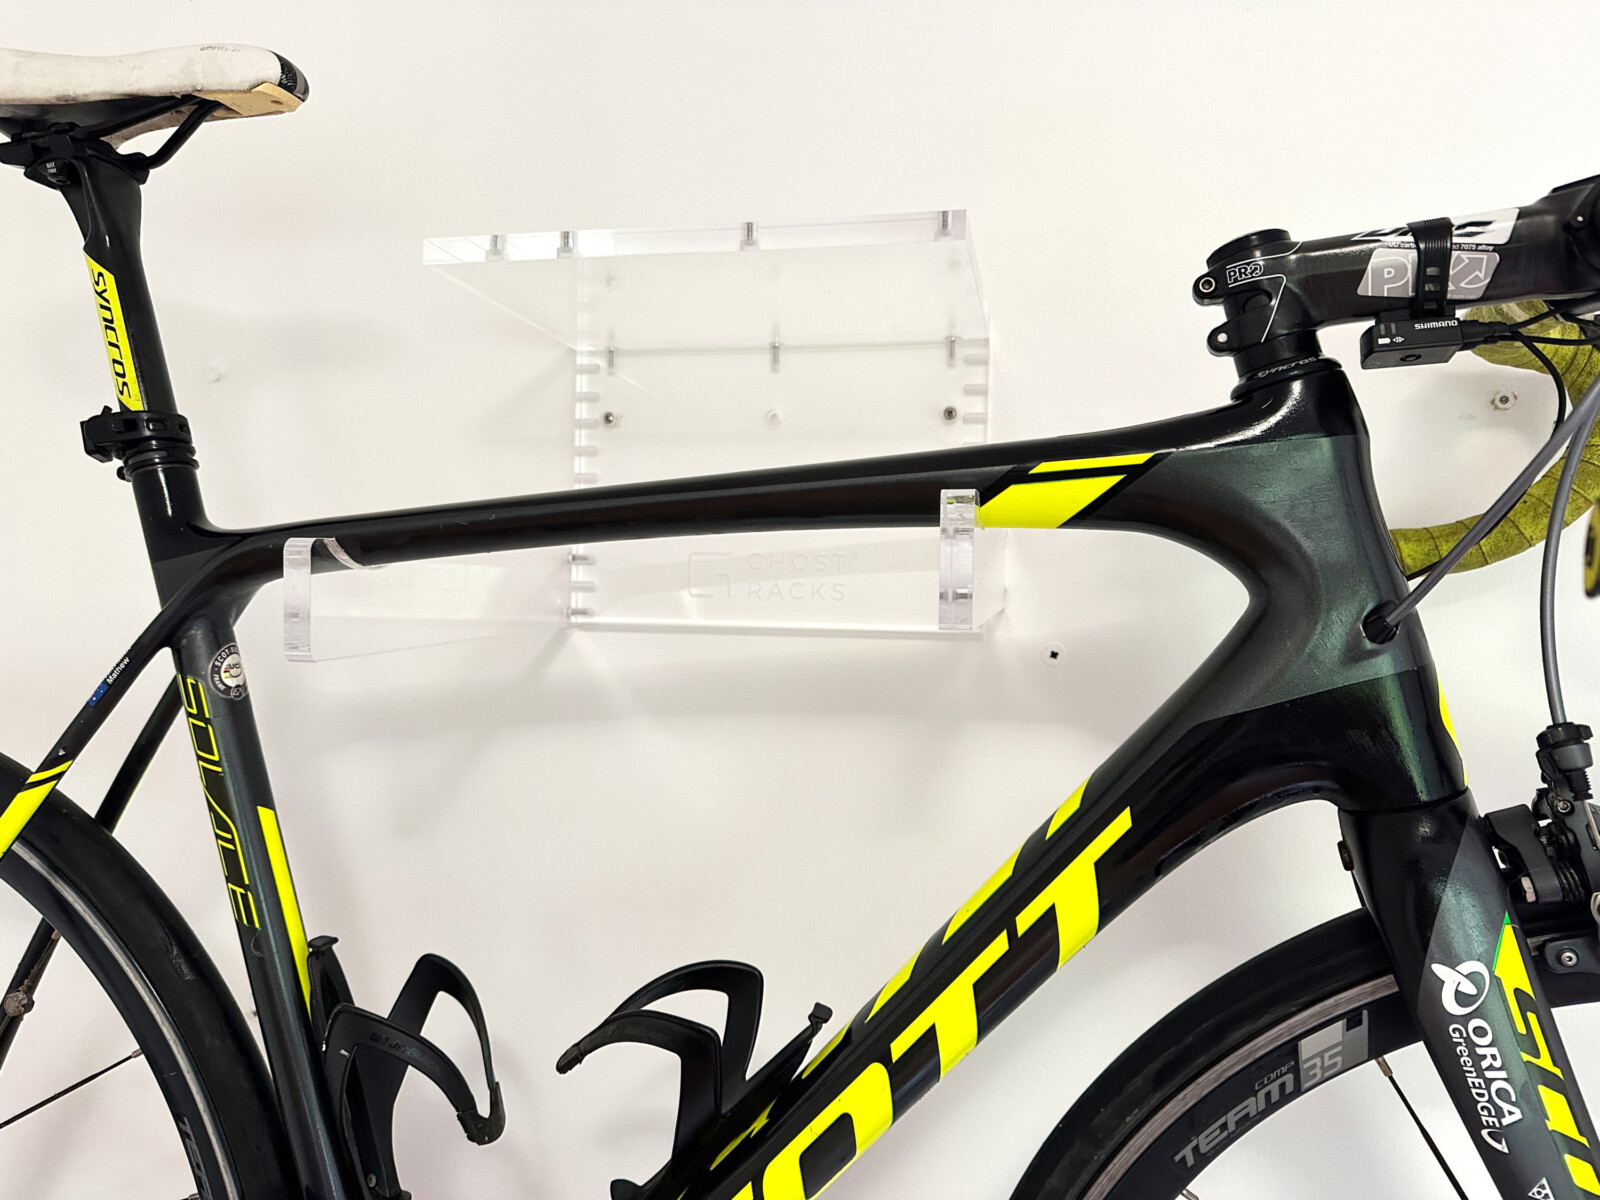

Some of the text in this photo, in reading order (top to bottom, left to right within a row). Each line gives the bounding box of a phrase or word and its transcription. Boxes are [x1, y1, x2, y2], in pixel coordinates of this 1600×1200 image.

[1414, 319, 1458, 330] SHIMANO
[748, 581, 845, 601] RACKS
[106, 656, 130, 685] Mathew
[177, 673, 261, 931] SOLACE
[730, 806, 1134, 1200] OTT
[1302, 1045, 1344, 1089] 35
[1448, 1023, 1501, 1131] GreenEDGE
[1467, 1017, 1524, 1127] ORICA
